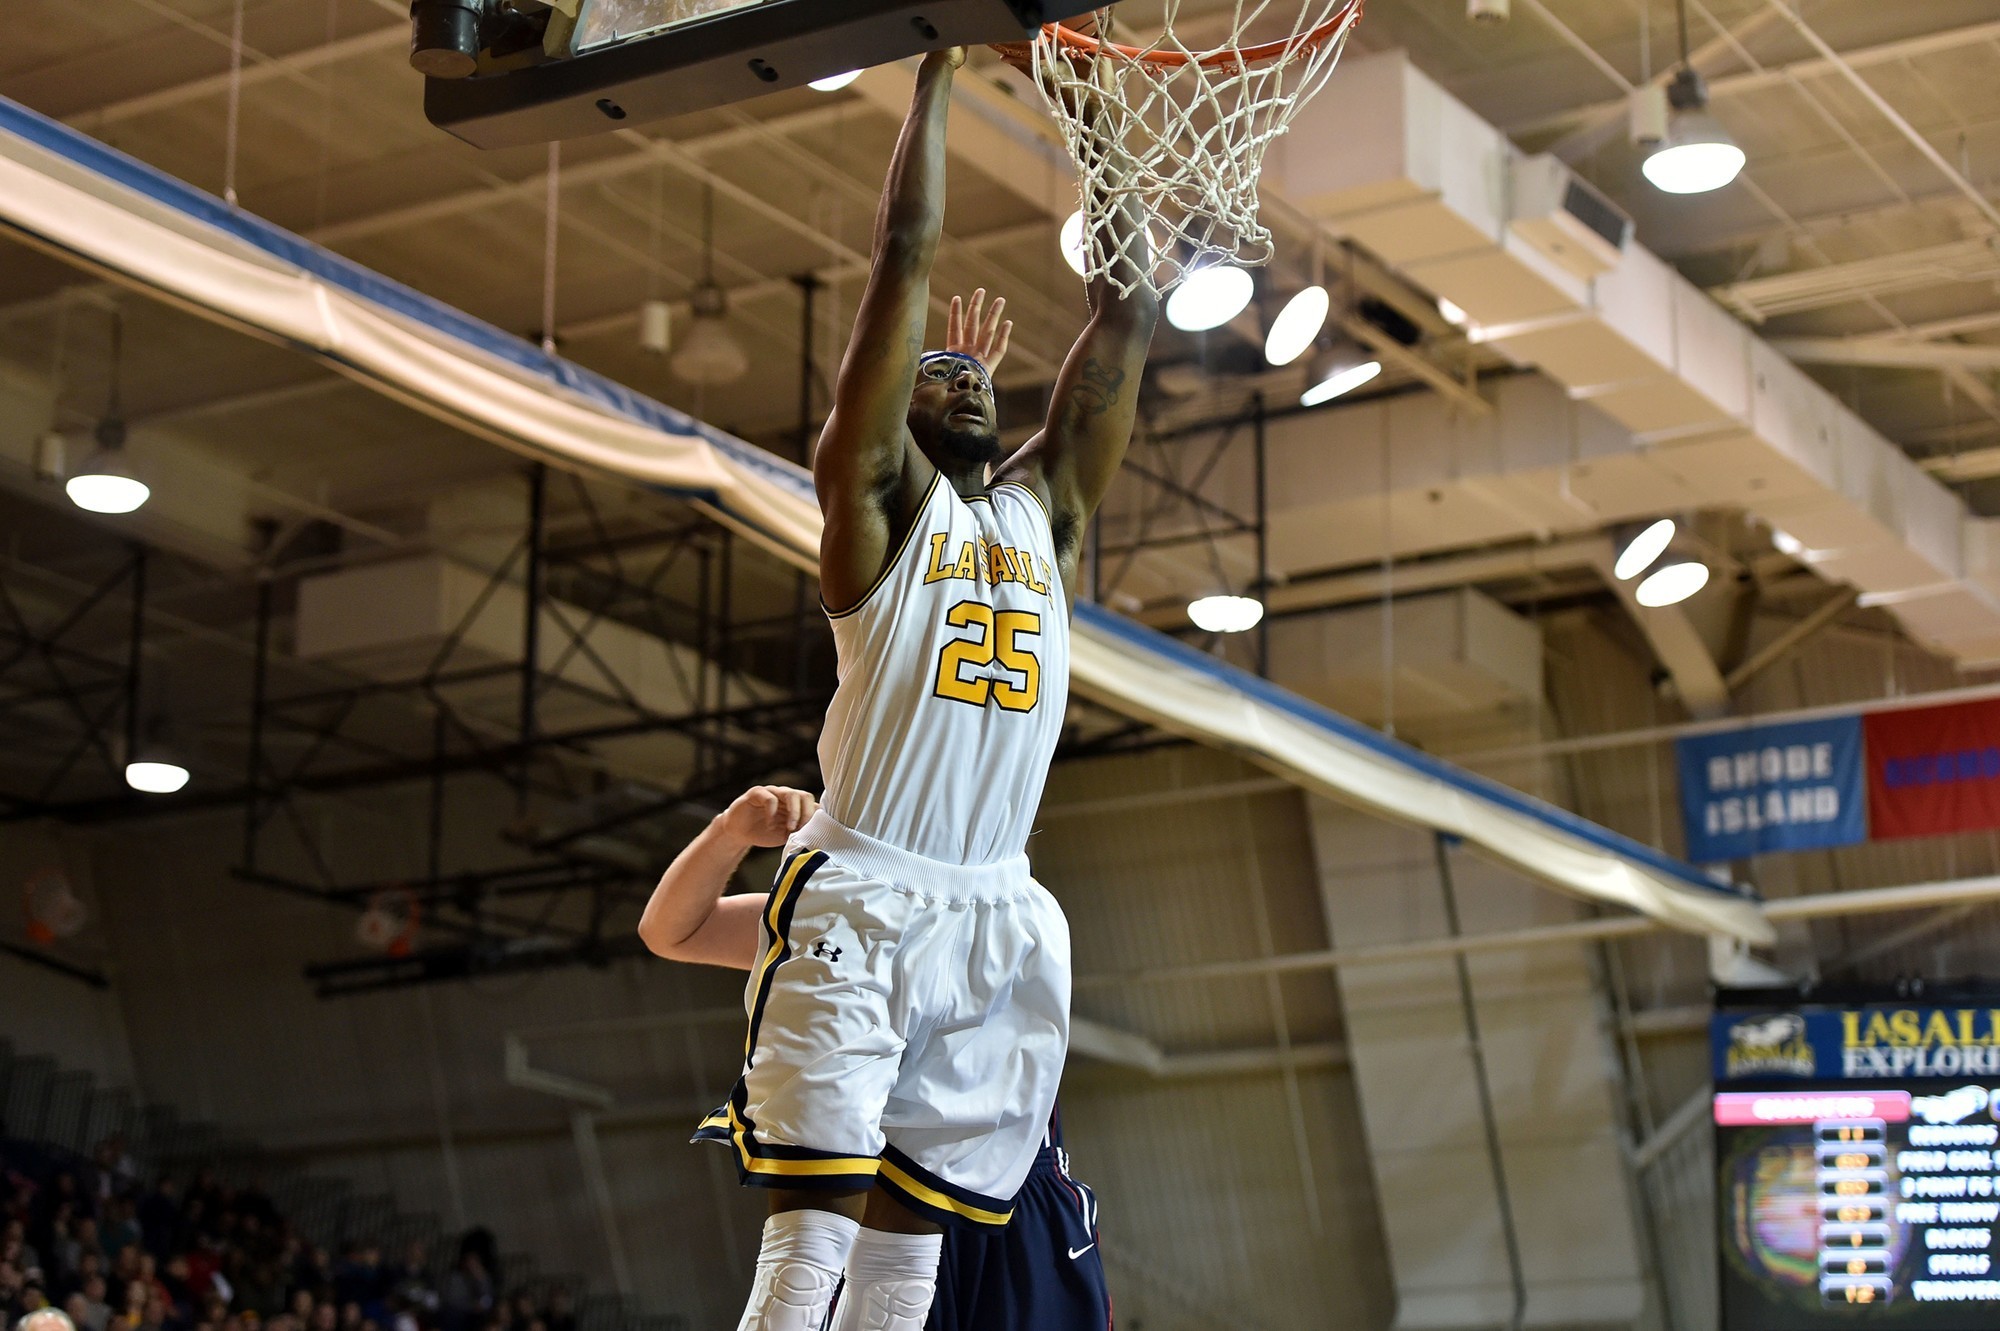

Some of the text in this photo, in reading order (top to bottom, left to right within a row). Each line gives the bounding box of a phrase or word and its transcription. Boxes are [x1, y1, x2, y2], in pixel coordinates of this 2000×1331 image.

[933, 599, 1041, 714] 25
[1708, 742, 1832, 791] RHODE
[1706, 787, 1839, 836] ISLAND
